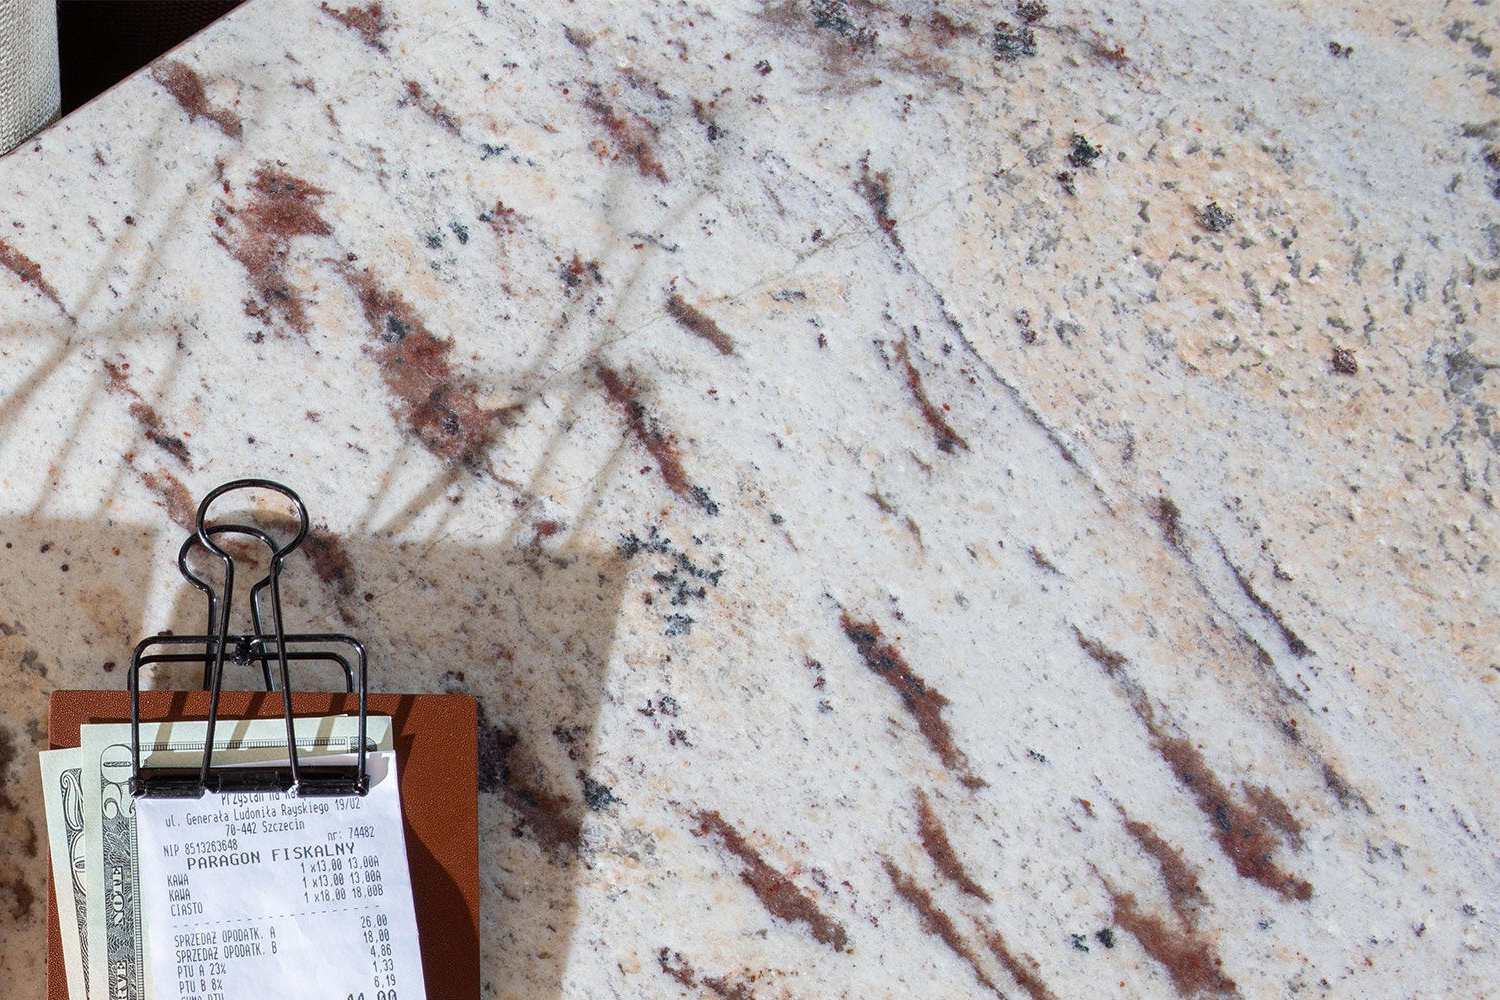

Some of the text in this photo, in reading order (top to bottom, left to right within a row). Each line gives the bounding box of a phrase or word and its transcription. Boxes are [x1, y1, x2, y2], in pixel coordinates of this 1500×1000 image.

[165, 815, 180, 827] ul.
[281, 802, 329, 817] Rayskiego
[225, 818, 305, 836] 70-442 Szczecin
[163, 844, 179, 857] NIP
[184, 838, 238, 855] 8513263648
[348, 826, 375, 838] 74482
[187, 841, 355, 870] PARAGON FISKALNY
[167, 873, 189, 887] KAWA
[300, 862, 305, 873] 1
[168, 888, 191, 902] KAWA
[302, 876, 307, 889] 1
[112, 866, 125, 925] NOTE
[170, 901, 203, 916] CIASTO
[304, 891, 309, 903] 1
[222, 927, 263, 943] OPODATK.
[269, 926, 276, 938] A
[360, 914, 388, 928] 26,00
[223, 942, 265, 959] OPODATK.
[271, 941, 277, 954] B
[363, 928, 390, 943] 18,00
[177, 943, 392, 978] PTU A 23% 4,86
[179, 958, 394, 994] PTU B 8% 1,33
[373, 973, 396, 988] 6,19
